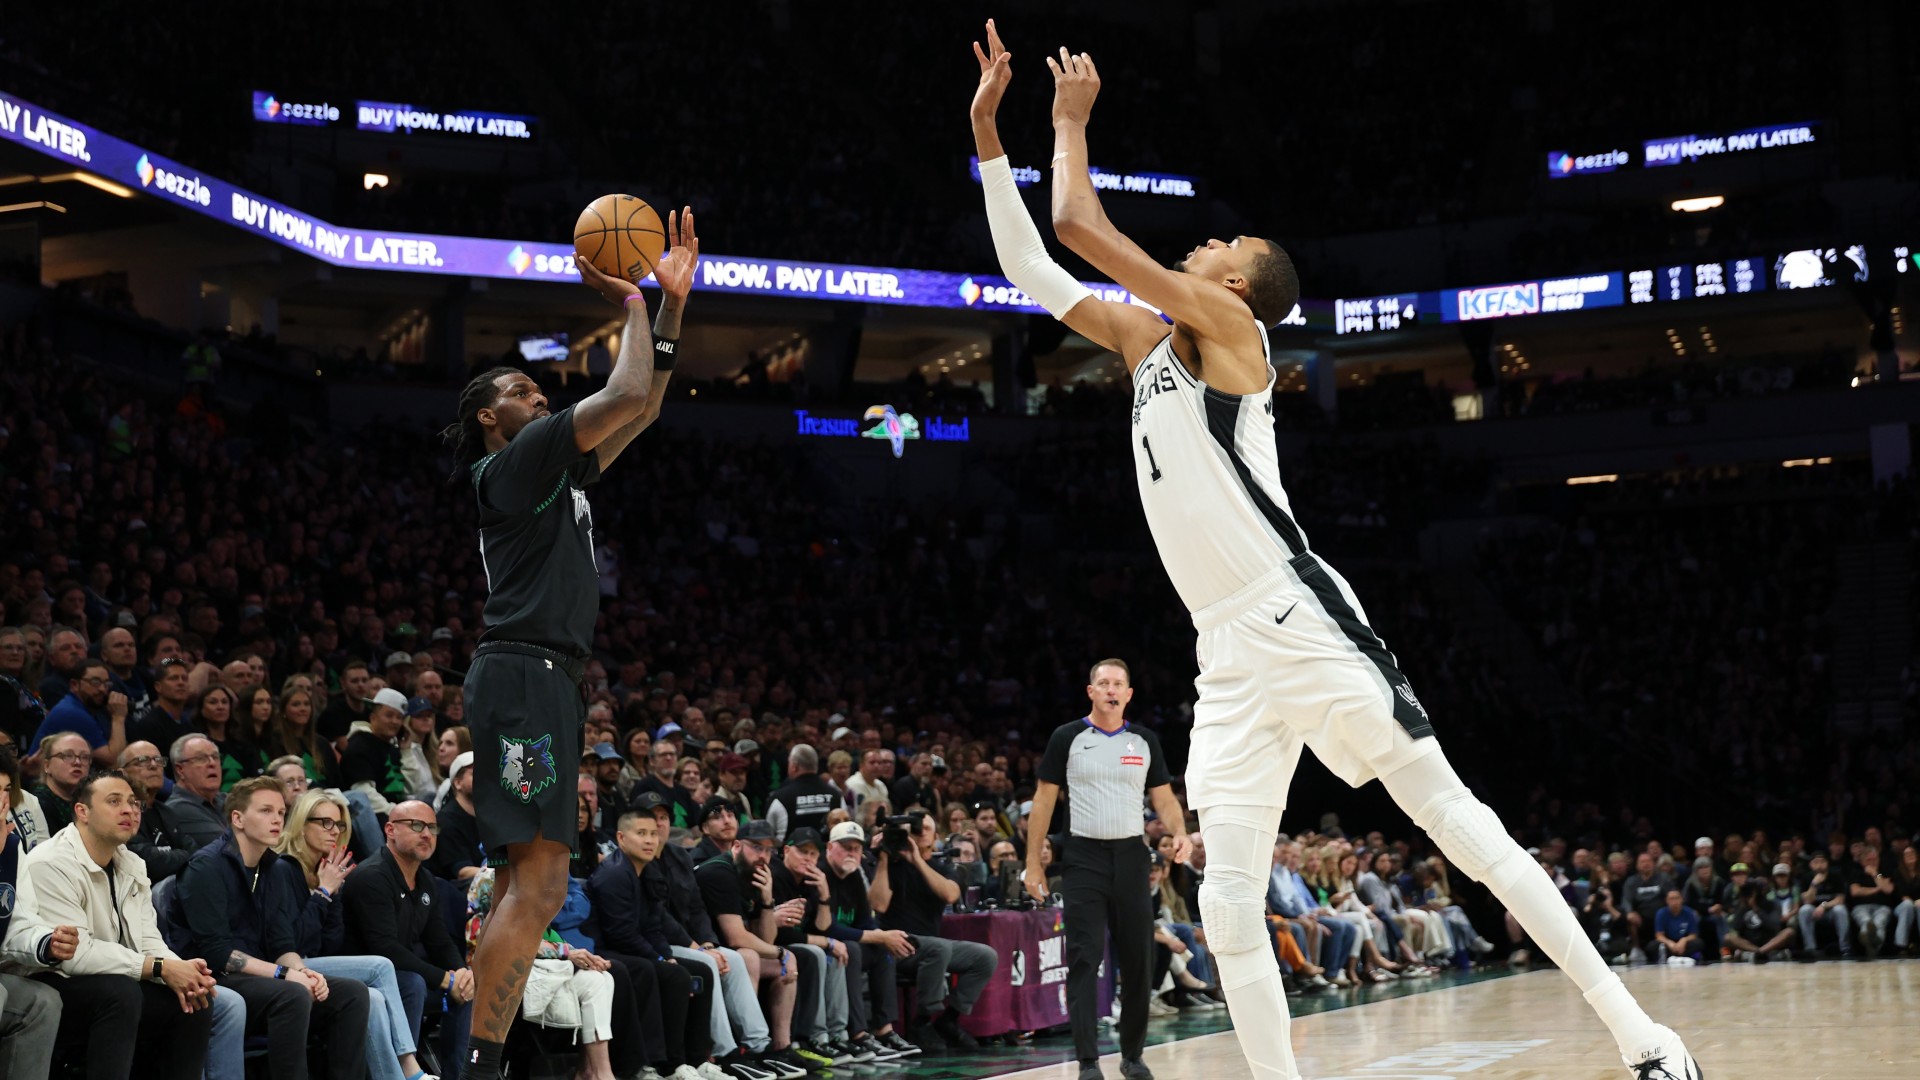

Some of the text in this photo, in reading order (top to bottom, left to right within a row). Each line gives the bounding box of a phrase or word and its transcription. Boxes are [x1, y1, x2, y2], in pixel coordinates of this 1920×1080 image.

[282, 102, 340, 121] sezzle
[358, 106, 530, 139] BUY NOW. PAY LATER.
[23, 109, 91, 162] LATER.
[1645, 127, 1815, 162] BUY NOW. PAY LATER.
[1574, 149, 1629, 169] sezzle
[155, 168, 211, 207] sezzle
[1124, 175, 1151, 192] PAY
[1151, 178, 1195, 197] LATER.
[231, 192, 444, 267] BUY NOW. PAY LATER.
[534, 254, 580, 275] sez
[703, 260, 772, 289] NOW.
[776, 266, 822, 292] PAY
[825, 270, 904, 298] LATER.
[1344, 299, 1373, 317] NYK
[1402, 303, 1415, 320] 4
[1459, 283, 1539, 320] KFAN
[1344, 315, 1373, 333] PHI
[793, 409, 970, 442] Treasure Island
[1143, 433, 1163, 485] 1
[796, 794, 833, 805] BEST
